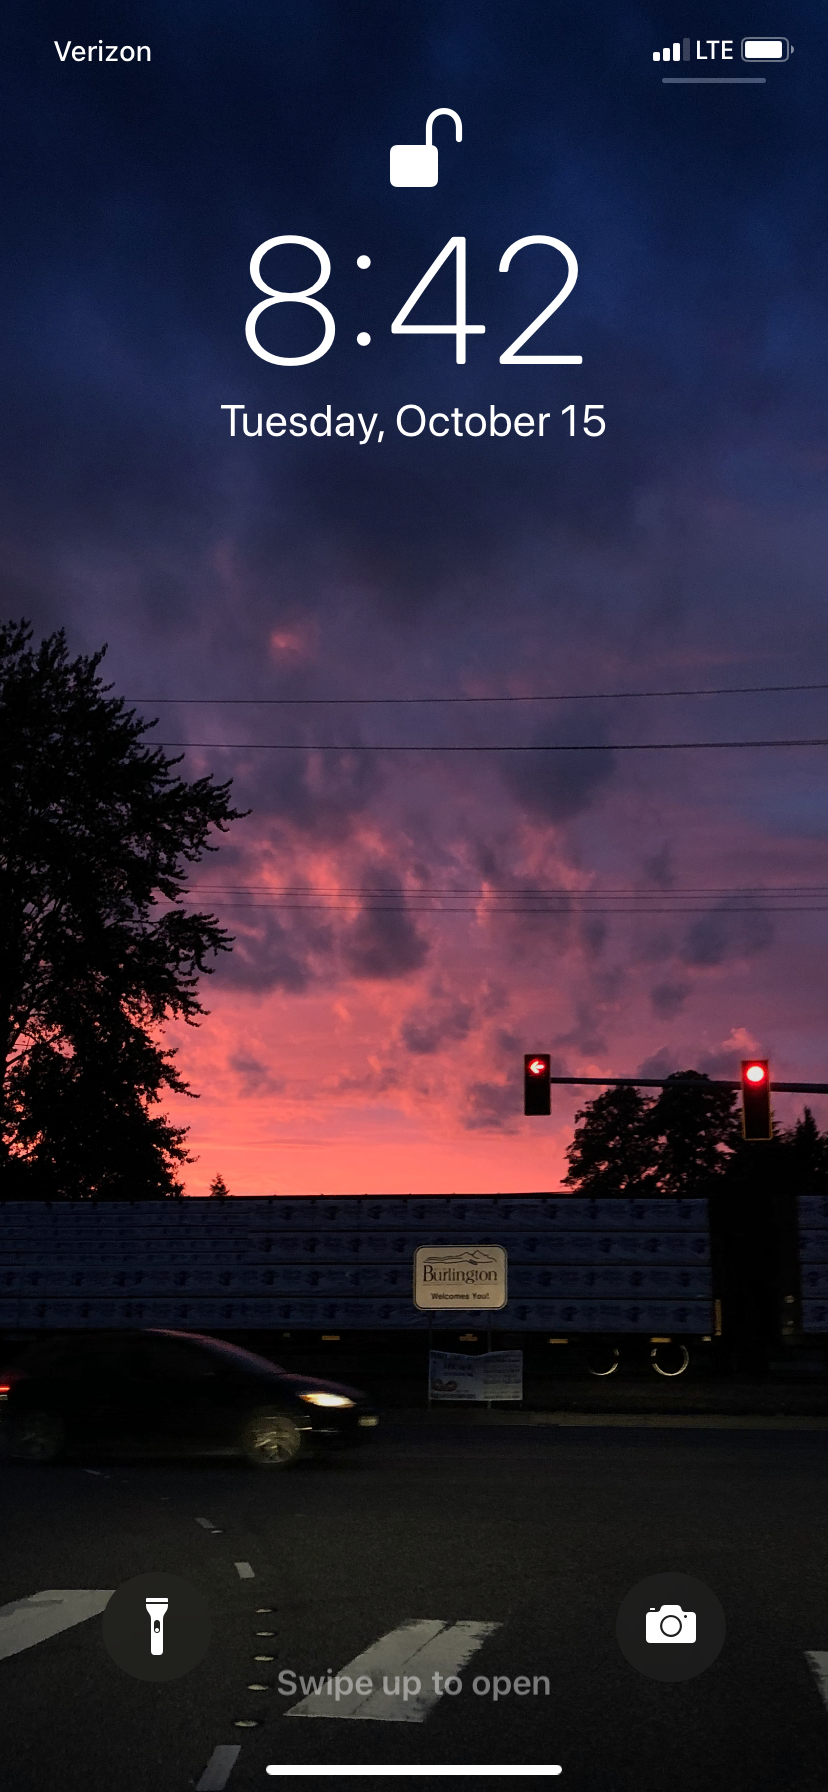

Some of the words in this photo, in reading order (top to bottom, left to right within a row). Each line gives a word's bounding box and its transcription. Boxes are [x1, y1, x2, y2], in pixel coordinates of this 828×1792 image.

[423, 1264, 498, 1285] Burlington
[430, 1292, 470, 1300] Welcomes
[472, 1292, 490, 1300] You!
